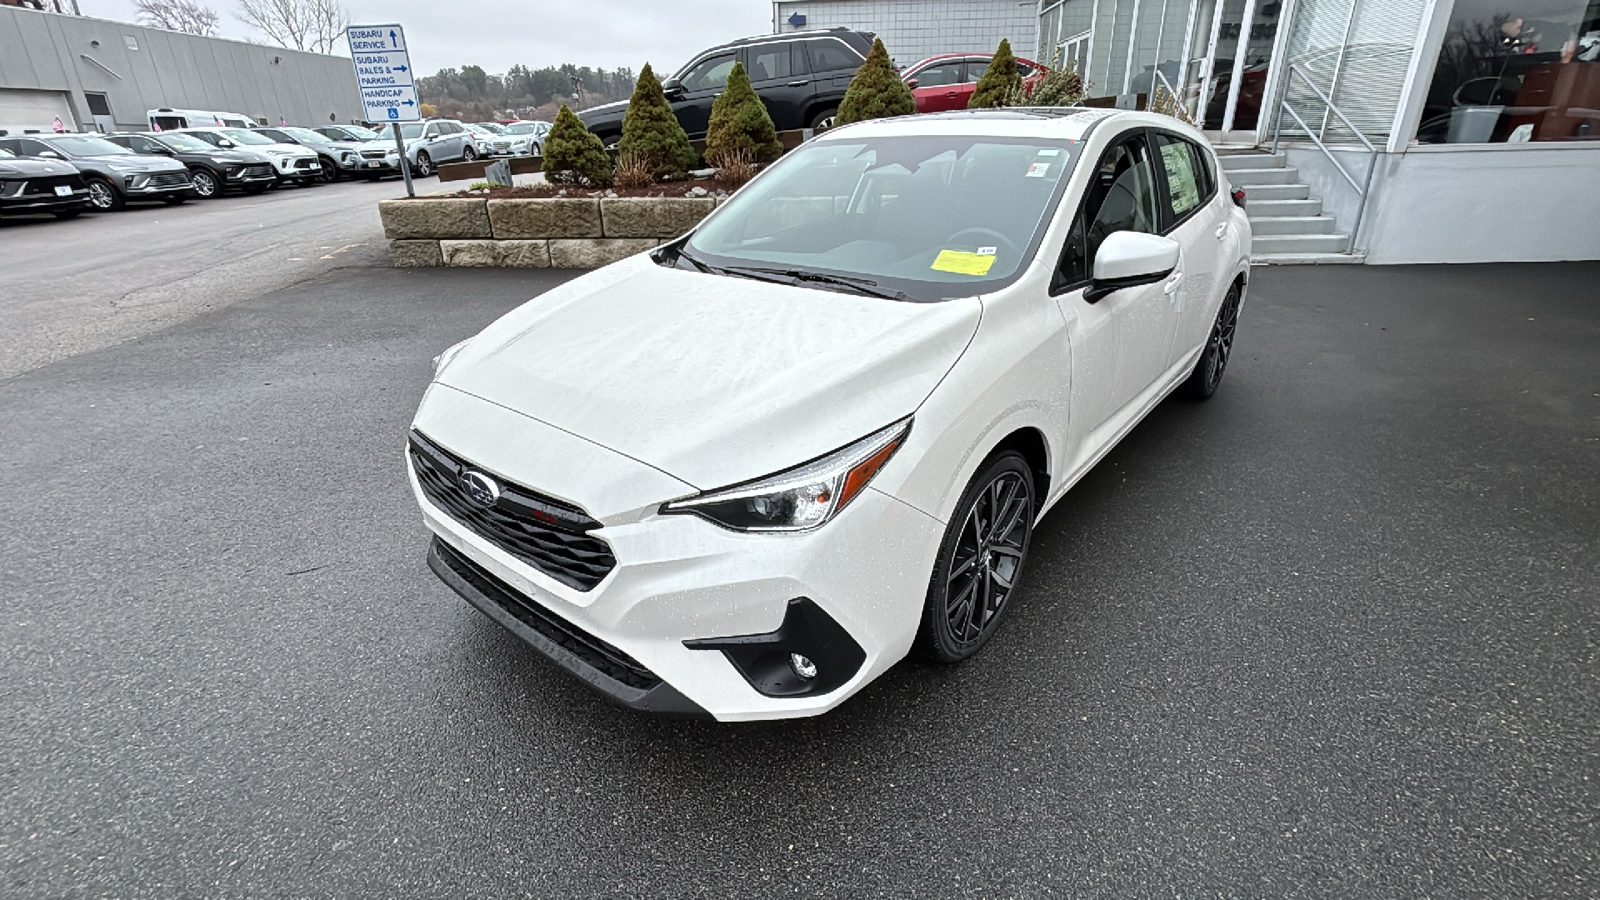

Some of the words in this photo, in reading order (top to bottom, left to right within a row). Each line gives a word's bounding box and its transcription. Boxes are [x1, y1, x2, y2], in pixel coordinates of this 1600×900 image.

[350, 30, 382, 38] SUBARU
[353, 41, 386, 49] SERVICE
[356, 56, 389, 64] SUBARU
[362, 77, 395, 85] PARKING
